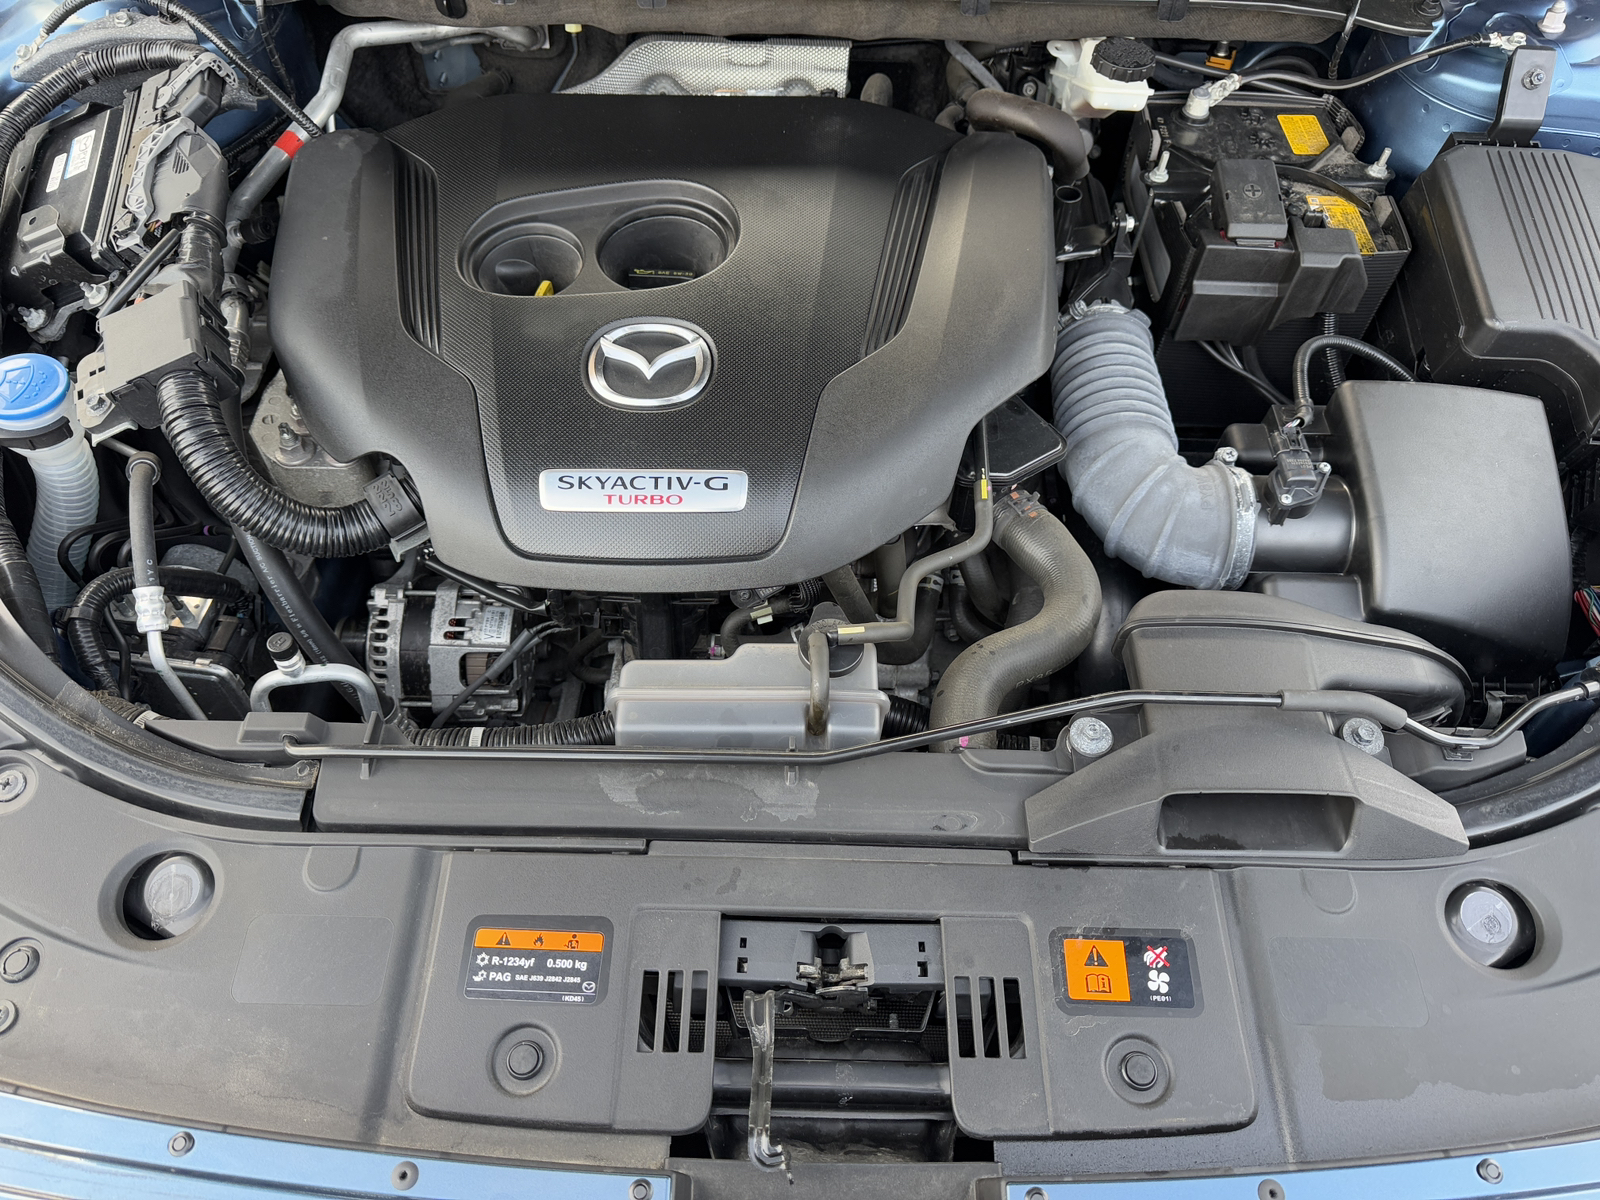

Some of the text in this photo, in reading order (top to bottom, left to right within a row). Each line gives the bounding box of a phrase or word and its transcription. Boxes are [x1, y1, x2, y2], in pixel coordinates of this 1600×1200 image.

[557, 475, 729, 491] SKYACTIV-G
[603, 494, 683, 505] TURBO
[246, 534, 263, 561] SUCTION
[267, 575, 299, 623] Flexbarrier
[491, 955, 588, 971] R-1234yf 0.500 kg
[488, 972, 512, 982] PAG
[544, 975, 562, 983] J2842
